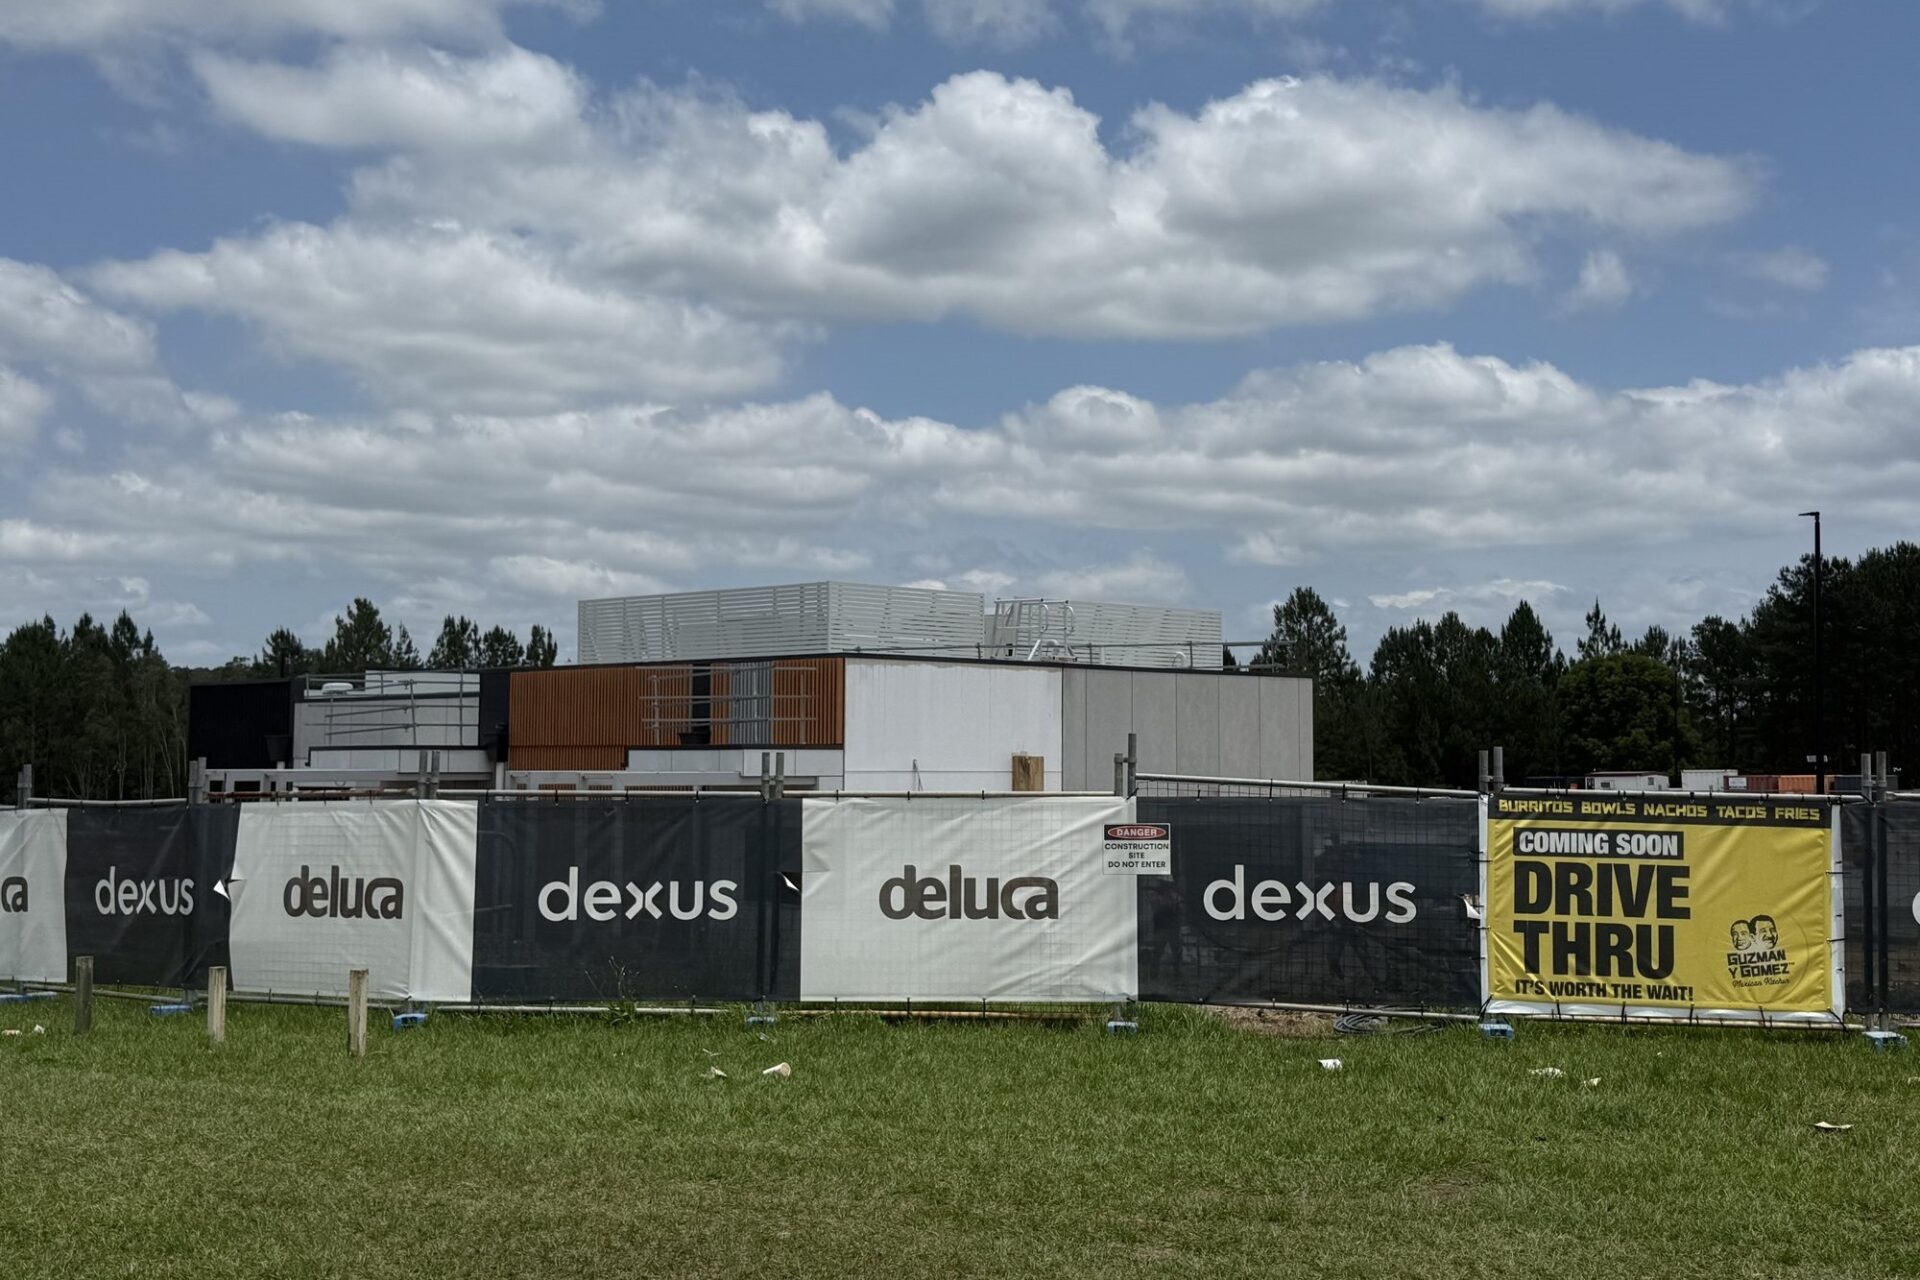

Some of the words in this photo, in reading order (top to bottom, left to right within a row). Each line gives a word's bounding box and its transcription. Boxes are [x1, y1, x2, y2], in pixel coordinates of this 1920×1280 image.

[1116, 828, 1157, 837] DANGER
[1498, 799, 1574, 814] BURRITOS
[1581, 801, 1636, 815] BOWLS
[1643, 803, 1708, 818] NACHOS
[1716, 805, 1767, 819] TACOS
[1774, 807, 1820, 821] FRIES
[1519, 830, 1609, 855] COMING
[1616, 832, 1678, 857] SOON
[94, 865, 195, 917] dexus
[283, 864, 404, 920] deluca
[538, 866, 738, 921] dexus
[878, 864, 1059, 920] deluca
[1203, 864, 1417, 924] dexus
[1513, 860, 1691, 920] DRIVE
[1513, 920, 1675, 979] THRU
[1727, 949, 1786, 966] GUZMAN
[1728, 967, 1738, 979] Y
[1546, 981, 1610, 998] WORTH
[1612, 982, 1643, 999] THE
[1645, 984, 1694, 1001] WAIT!
